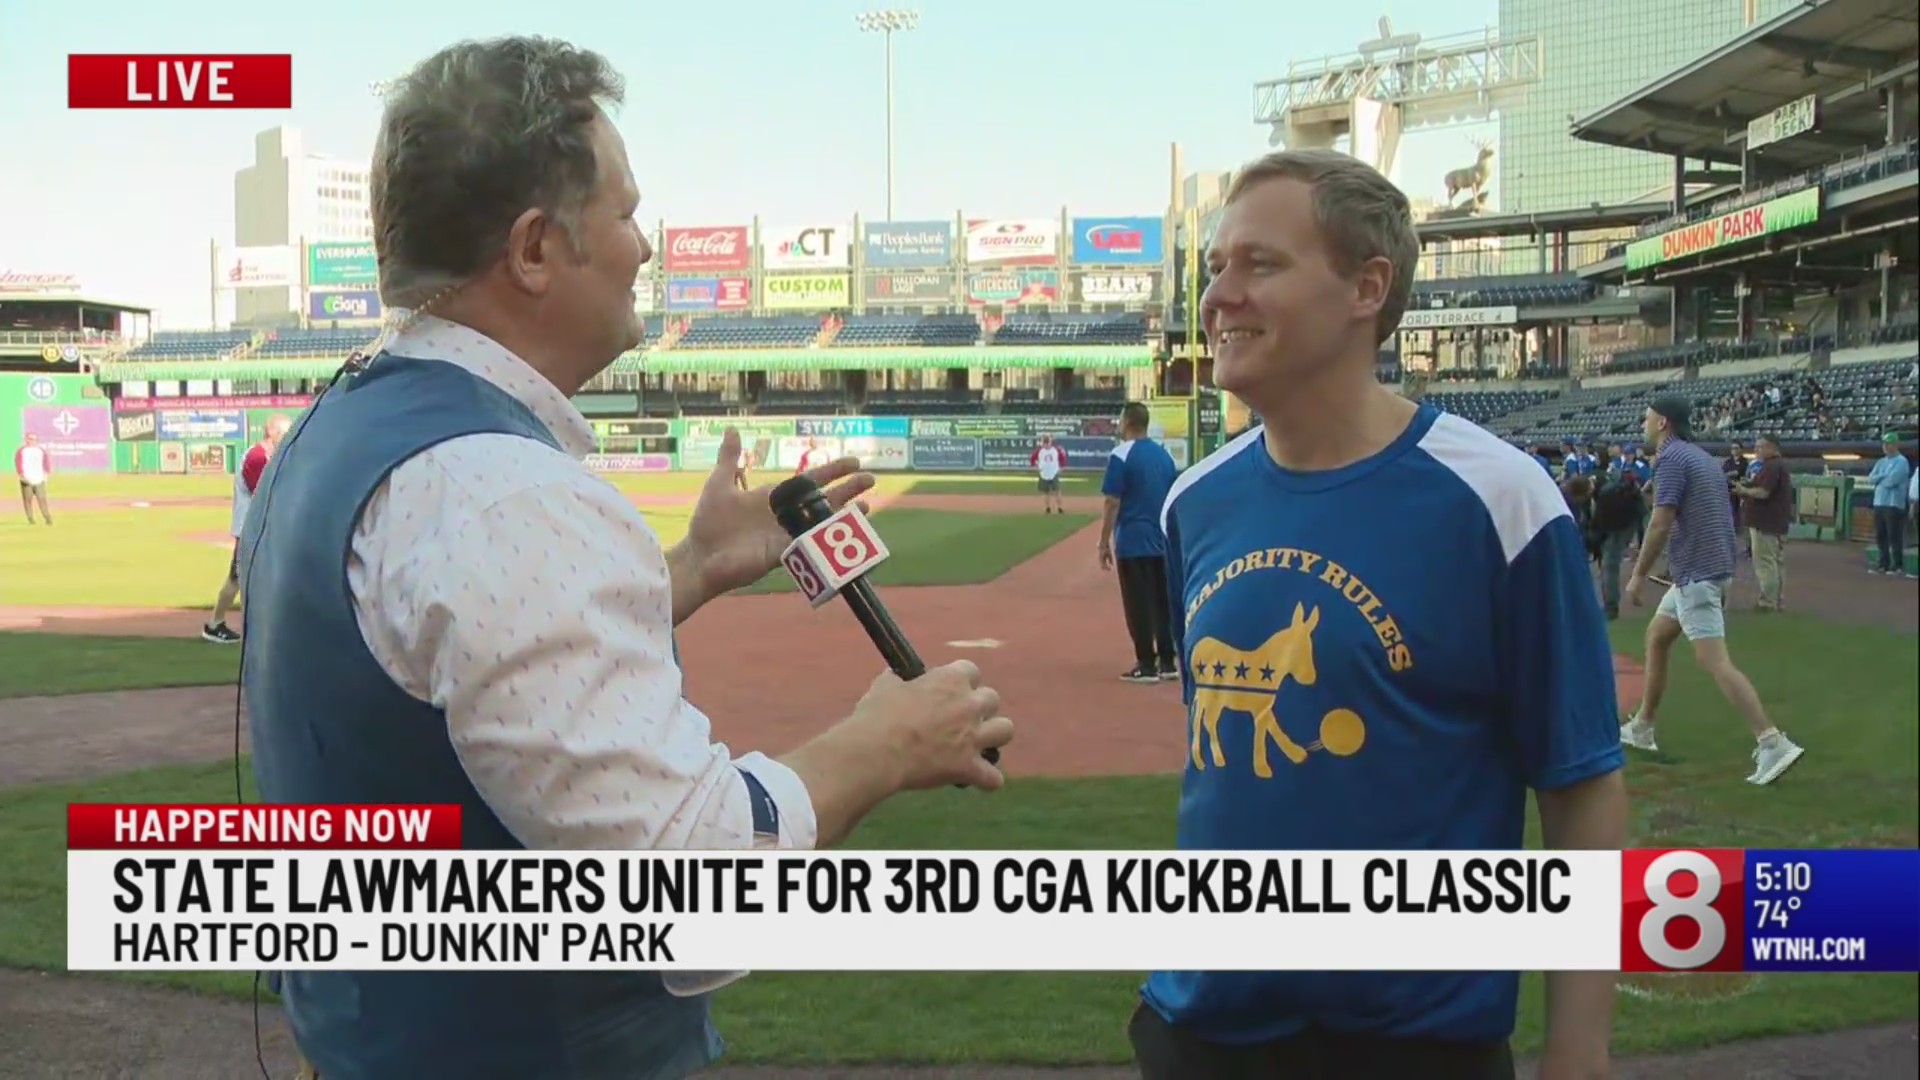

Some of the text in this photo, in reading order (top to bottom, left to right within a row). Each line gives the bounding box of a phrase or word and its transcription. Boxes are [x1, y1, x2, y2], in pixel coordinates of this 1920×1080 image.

[798, 228, 835, 256] CT
[1662, 206, 1765, 260] DUNKIN' PARK
[316, 246, 376, 259] EVERSOURC
[768, 278, 844, 293] CUSTOM
[1434, 312, 1486, 325] TERRACE
[800, 419, 874, 435] STRATIS
[824, 521, 868, 568] 8
[788, 554, 819, 596] 8
[1186, 547, 1413, 673] MAJORITY RULES
